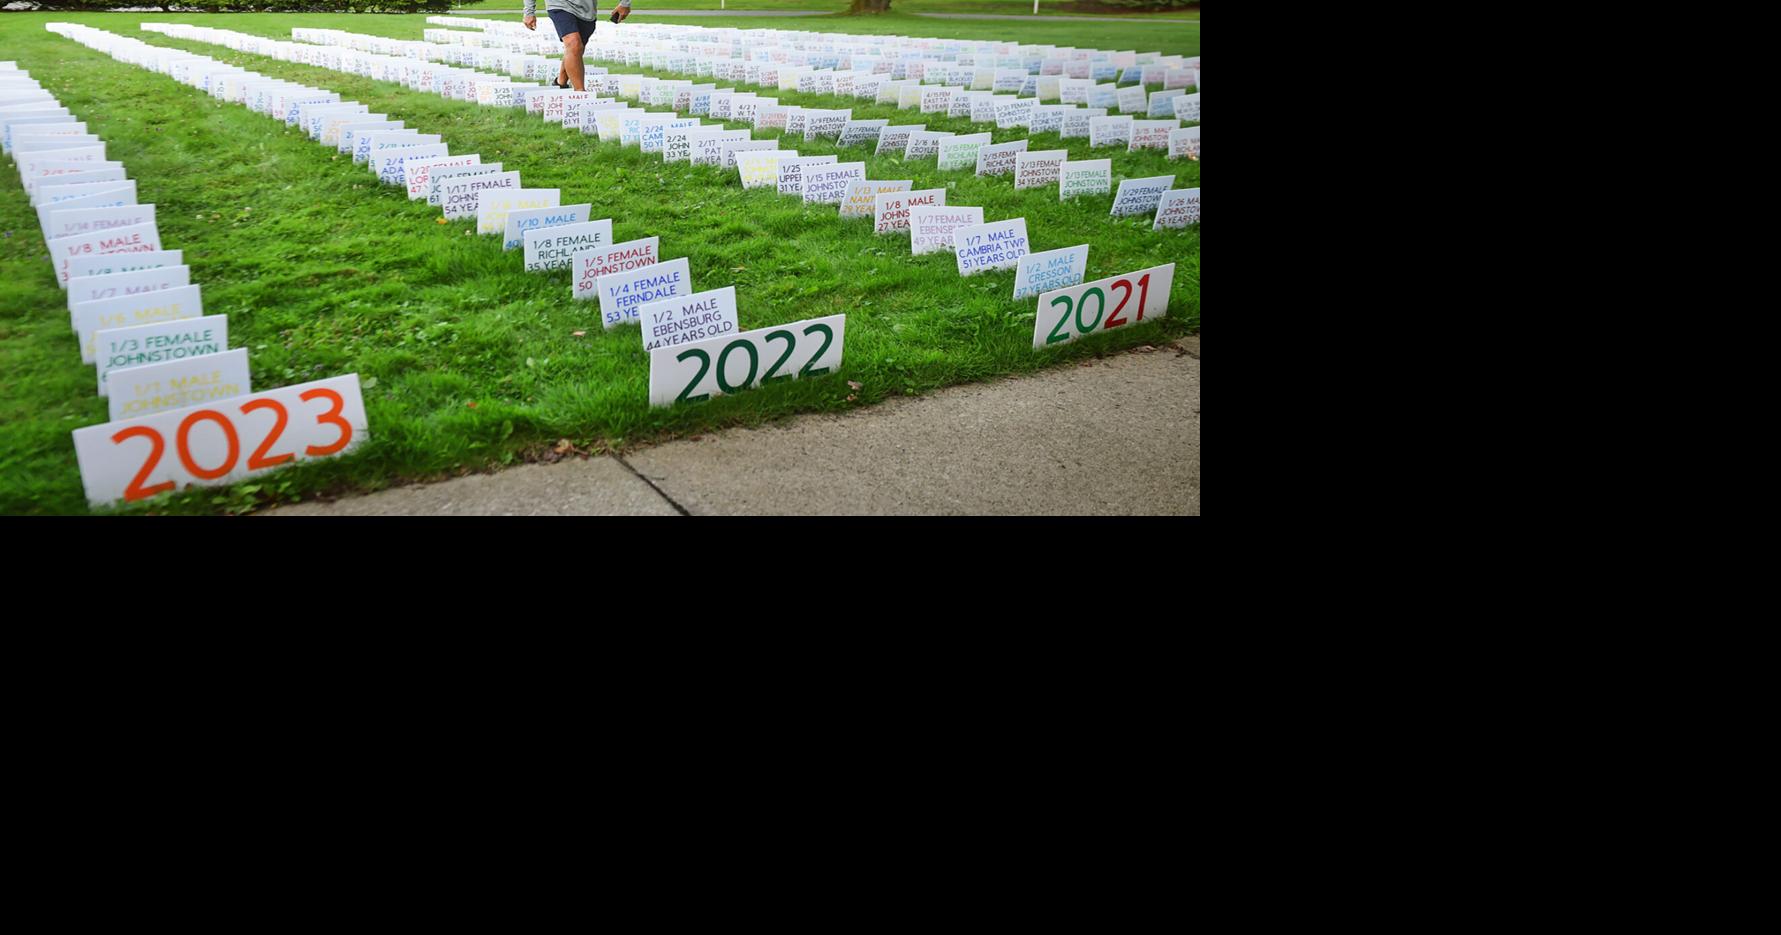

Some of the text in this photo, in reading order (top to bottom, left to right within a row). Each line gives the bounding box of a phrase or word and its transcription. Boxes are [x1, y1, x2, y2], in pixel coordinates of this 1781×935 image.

[998, 108, 1031, 117] JOHNSTOW
[809, 123, 845, 132] JOHNSTOW
[667, 135, 686, 143] 2/24
[698, 139, 716, 148] 2/17
[881, 140, 908, 148] JOHNSTO
[386, 157, 404, 166] 2/4
[947, 151, 977, 159] RICHLAN
[382, 166, 405, 175] ADA
[783, 164, 801, 174] 1/25
[985, 159, 1016, 168] RICHLAN
[806, 169, 860, 183] 1/15 FEMALE
[1081, 169, 1107, 178] FEMALE
[446, 184, 467, 195] 1/17
[471, 178, 512, 191] FEMALE
[806, 180, 848, 193] JOHNSTO
[1027, 177, 1049, 185] YEARS
[1064, 179, 1108, 188] JOHNSTOWN
[779, 184, 788, 193] 31
[816, 190, 845, 201] YEARS
[1139, 185, 1167, 195] FEMALE
[430, 194, 439, 203] 61
[446, 192, 479, 205] JOHNS
[885, 195, 935, 211] 1/8 MALE
[444, 202, 479, 214] 54 YEA
[880, 208, 910, 222] JOHNS
[1161, 205, 1200, 216] JOHNSTO
[517, 217, 539, 229] 1/10
[544, 212, 577, 225] MALE
[878, 219, 910, 232] 27 YEA
[918, 214, 973, 224] 1/7 FEMALE
[1168, 215, 1193, 224] YEARS
[533, 238, 552, 250] 1/8
[556, 232, 601, 247] FEMALE
[927, 235, 954, 246] YEAR
[966, 228, 1015, 247] 1/7 MALE
[67, 233, 142, 257] 1/8 MALE
[958, 237, 1026, 259] CAMBRIA TWP
[585, 245, 652, 268] 1/5 FEMALE
[963, 248, 1026, 269] 51 YEARS OLD
[527, 262, 541, 272] 35
[582, 255, 657, 280] JOHNSTOWN
[1026, 253, 1075, 275] 1/2 MALE
[1028, 264, 1072, 284] CRESSON
[578, 280, 593, 292] 50
[609, 271, 681, 298] 1/4 FEMALE
[1016, 287, 1027, 298] 37
[1029, 277, 1060, 294] YEARS
[616, 284, 677, 308] FERNDALE
[652, 309, 674, 324] 1/2
[682, 297, 719, 316] MALE
[1046, 273, 1150, 345] 2021
[606, 310, 621, 324] 53
[652, 310, 723, 338] EBENSBURG
[110, 338, 139, 354] 1/3
[145, 328, 213, 349] FEMALE
[646, 320, 733, 351] 44 YEARS OLD
[106, 342, 219, 368] JOHNSTOWN
[673, 322, 834, 404] 2022
[169, 369, 222, 391] MALE
[121, 383, 241, 415] JOHNSTOWN
[111, 387, 353, 501] 2023
